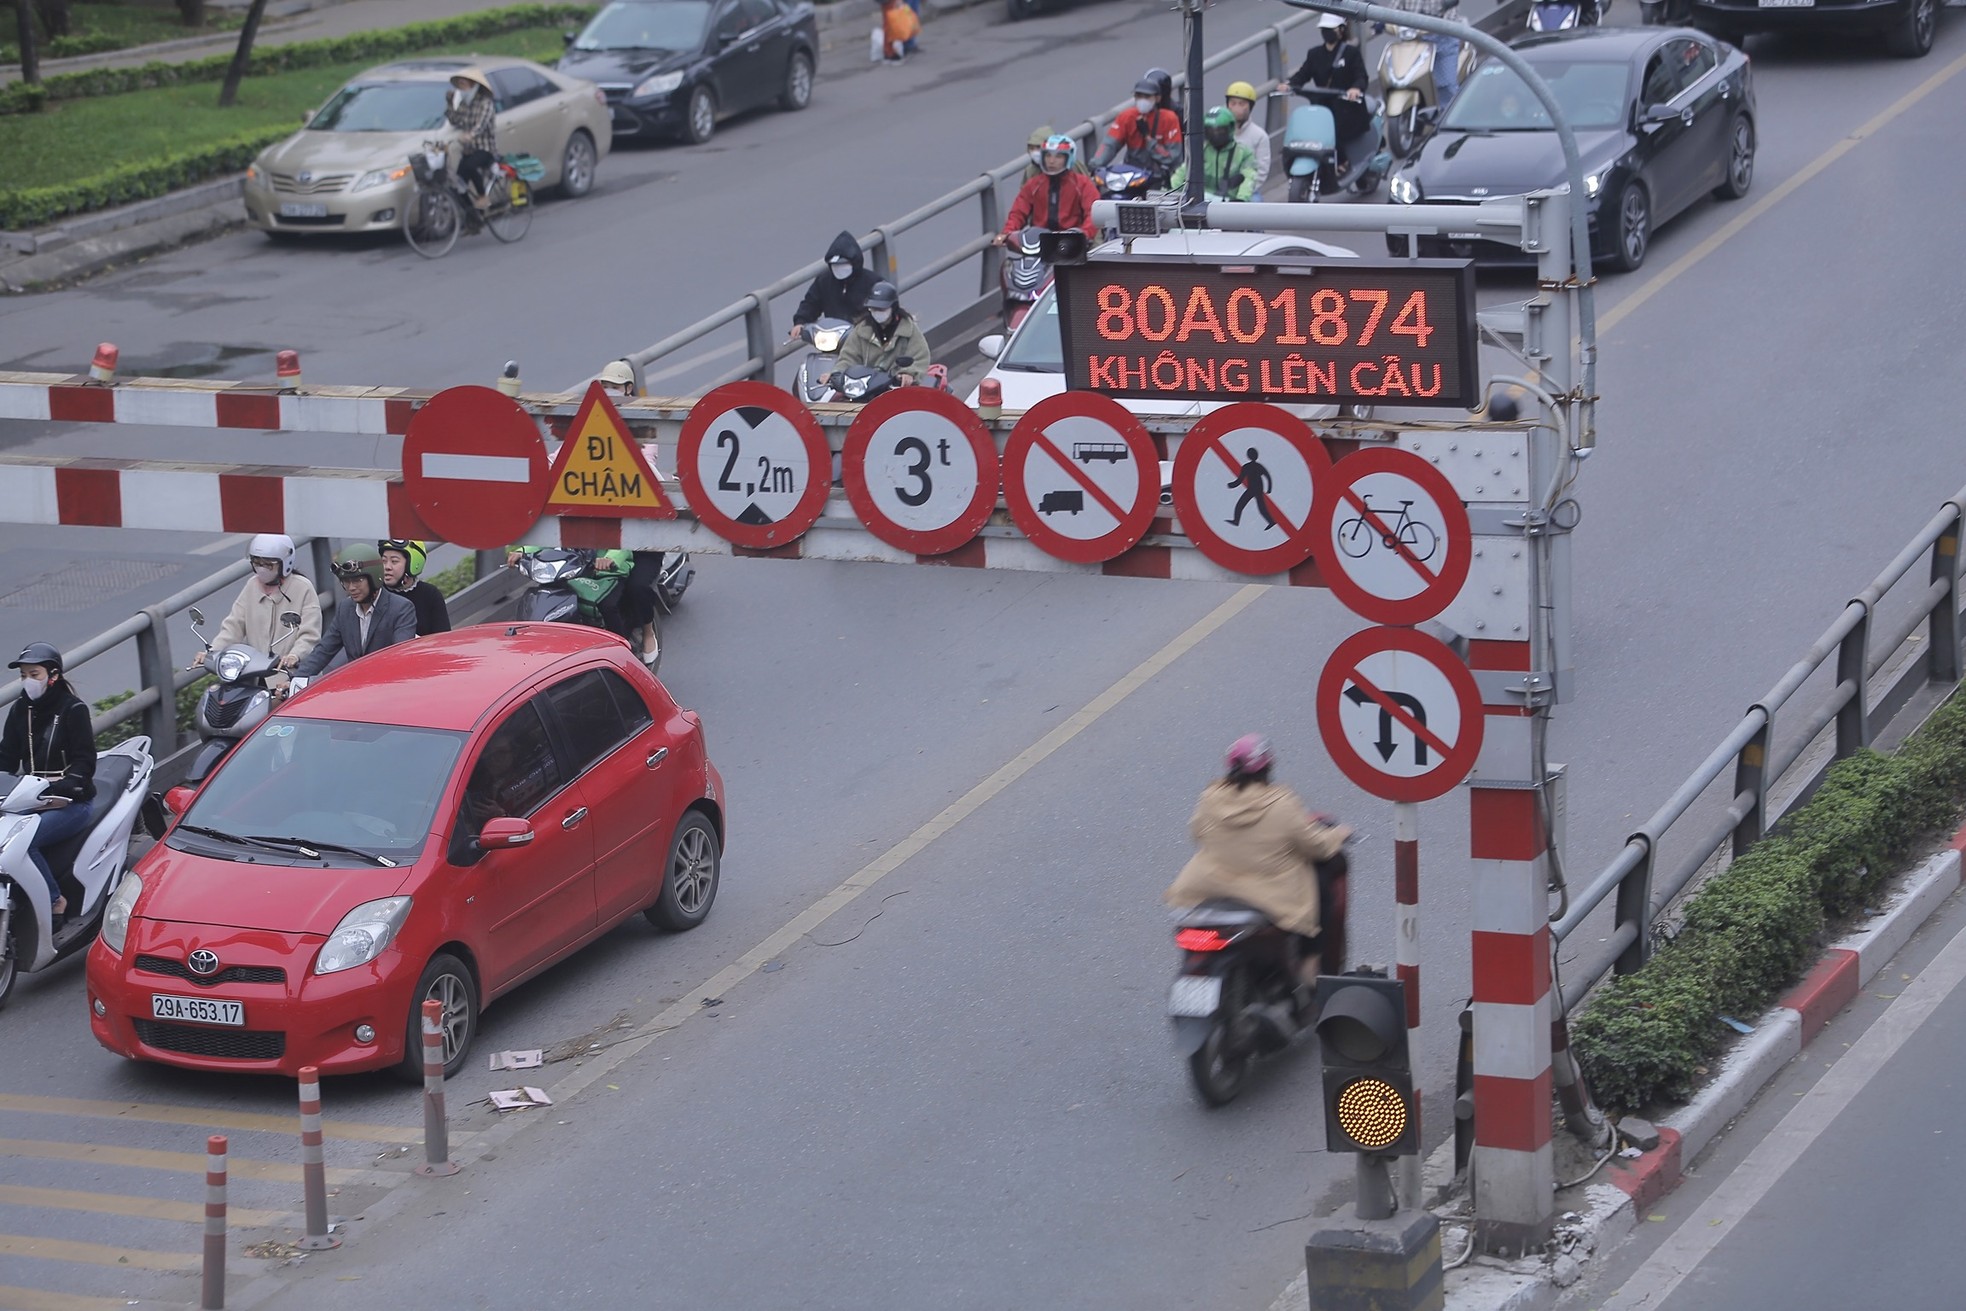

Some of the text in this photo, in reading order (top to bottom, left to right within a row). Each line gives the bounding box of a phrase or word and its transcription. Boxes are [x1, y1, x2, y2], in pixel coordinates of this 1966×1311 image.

[1096, 284, 1434, 349] 80A01874
[1088, 350, 1441, 397] KHÔNG LÊN CẦU
[587, 436, 613, 461] ĐI
[564, 467, 641, 502] CHẬM
[154, 997, 240, 1023] 29A-653.17
